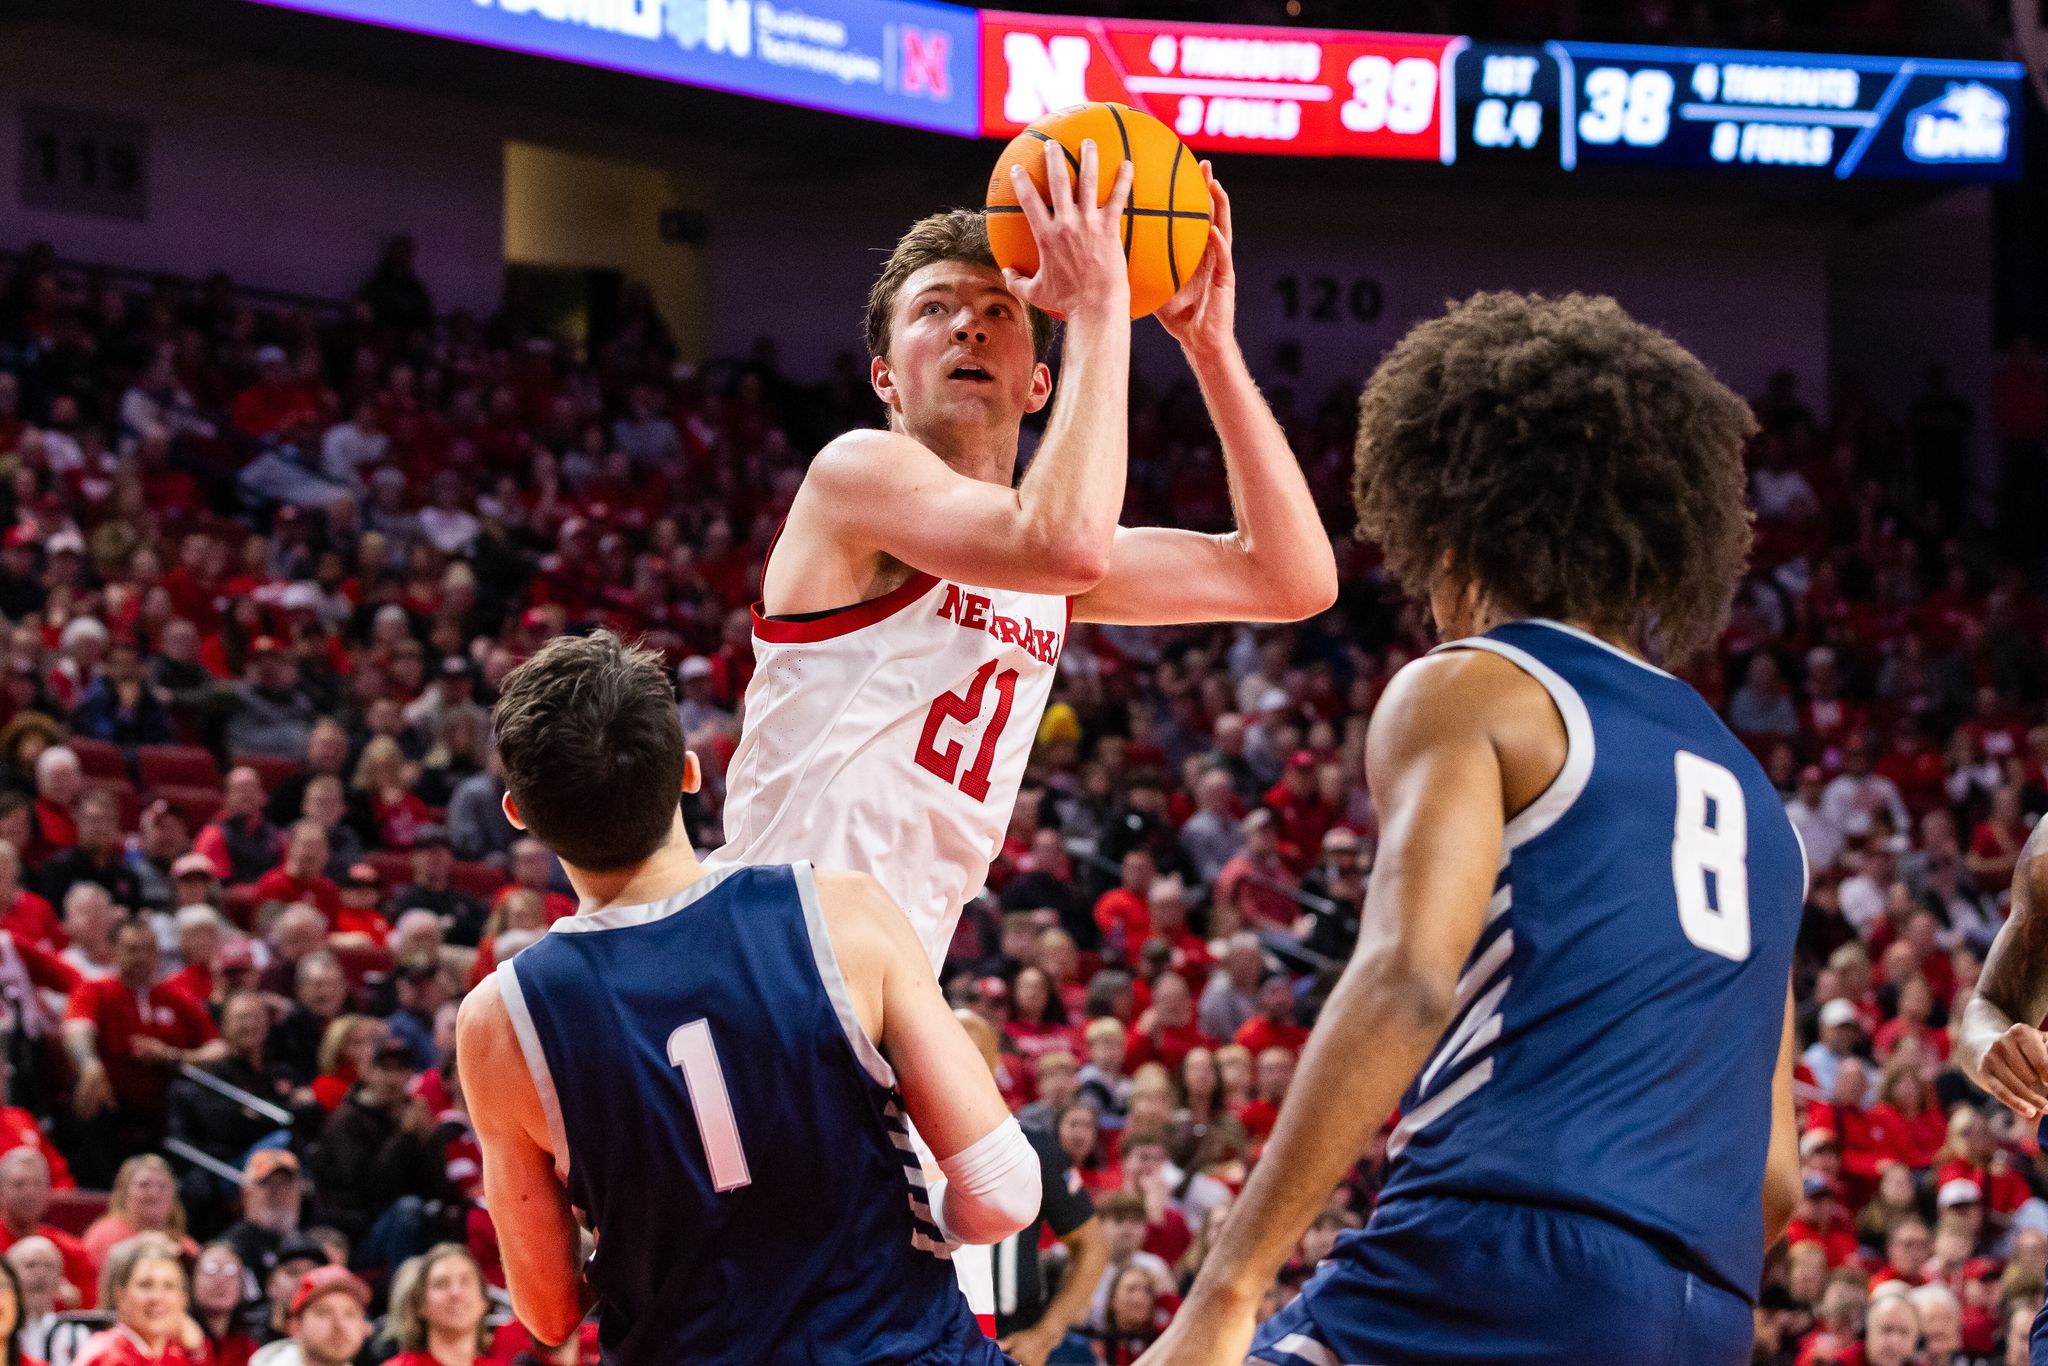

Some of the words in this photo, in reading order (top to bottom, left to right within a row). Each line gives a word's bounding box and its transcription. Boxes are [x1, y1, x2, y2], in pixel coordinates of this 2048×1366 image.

[903, 29, 949, 97] N
[1003, 31, 1090, 124] N
[1180, 35, 1322, 82] TIMEOUTS
[1340, 55, 1439, 135] 39
[1722, 63, 1860, 109] TIMEOUTS
[1204, 96, 1301, 141] FOULS
[1578, 67, 1675, 147] 38
[1738, 123, 1834, 167] FOULS
[1275, 275, 1382, 323] 120
[914, 658, 1020, 803] 21
[1672, 749, 1751, 962] 8
[667, 1018, 752, 1193] 1
